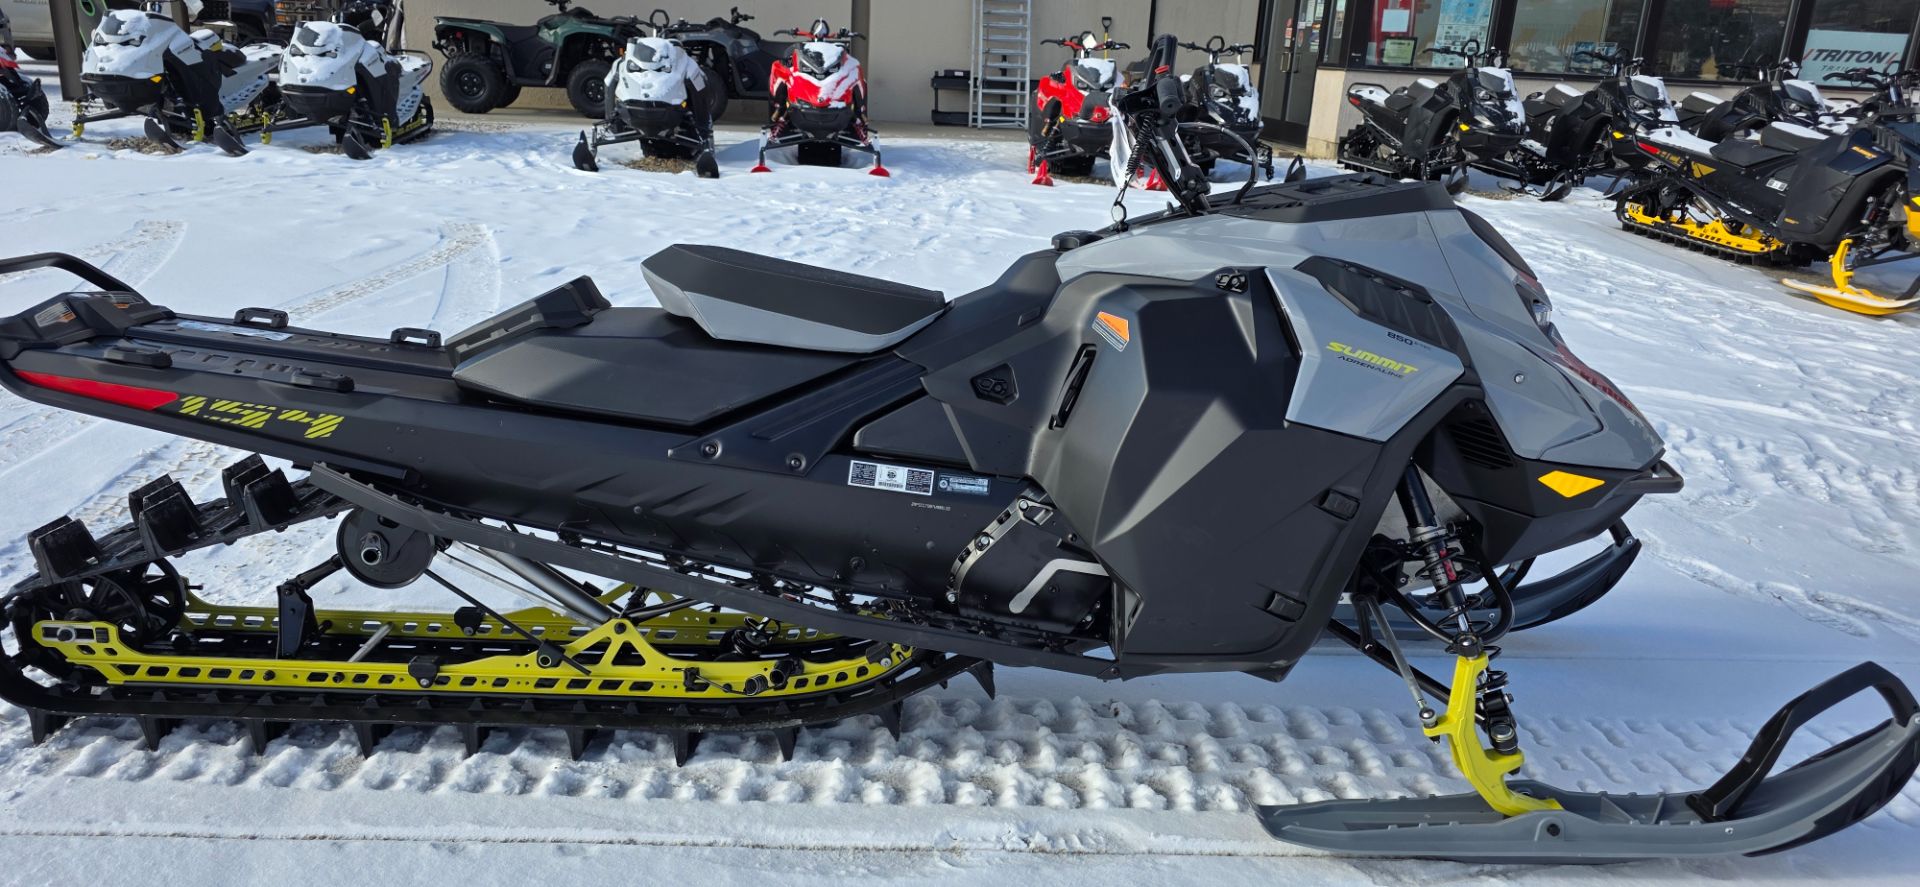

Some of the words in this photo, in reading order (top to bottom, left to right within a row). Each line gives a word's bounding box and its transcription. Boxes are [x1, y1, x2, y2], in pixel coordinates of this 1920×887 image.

[1813, 48, 1890, 63] TRITON
[1386, 331, 1413, 346] 850
[1326, 341, 1419, 374] SUMMIT
[1337, 355, 1404, 378] ADRENALINE
